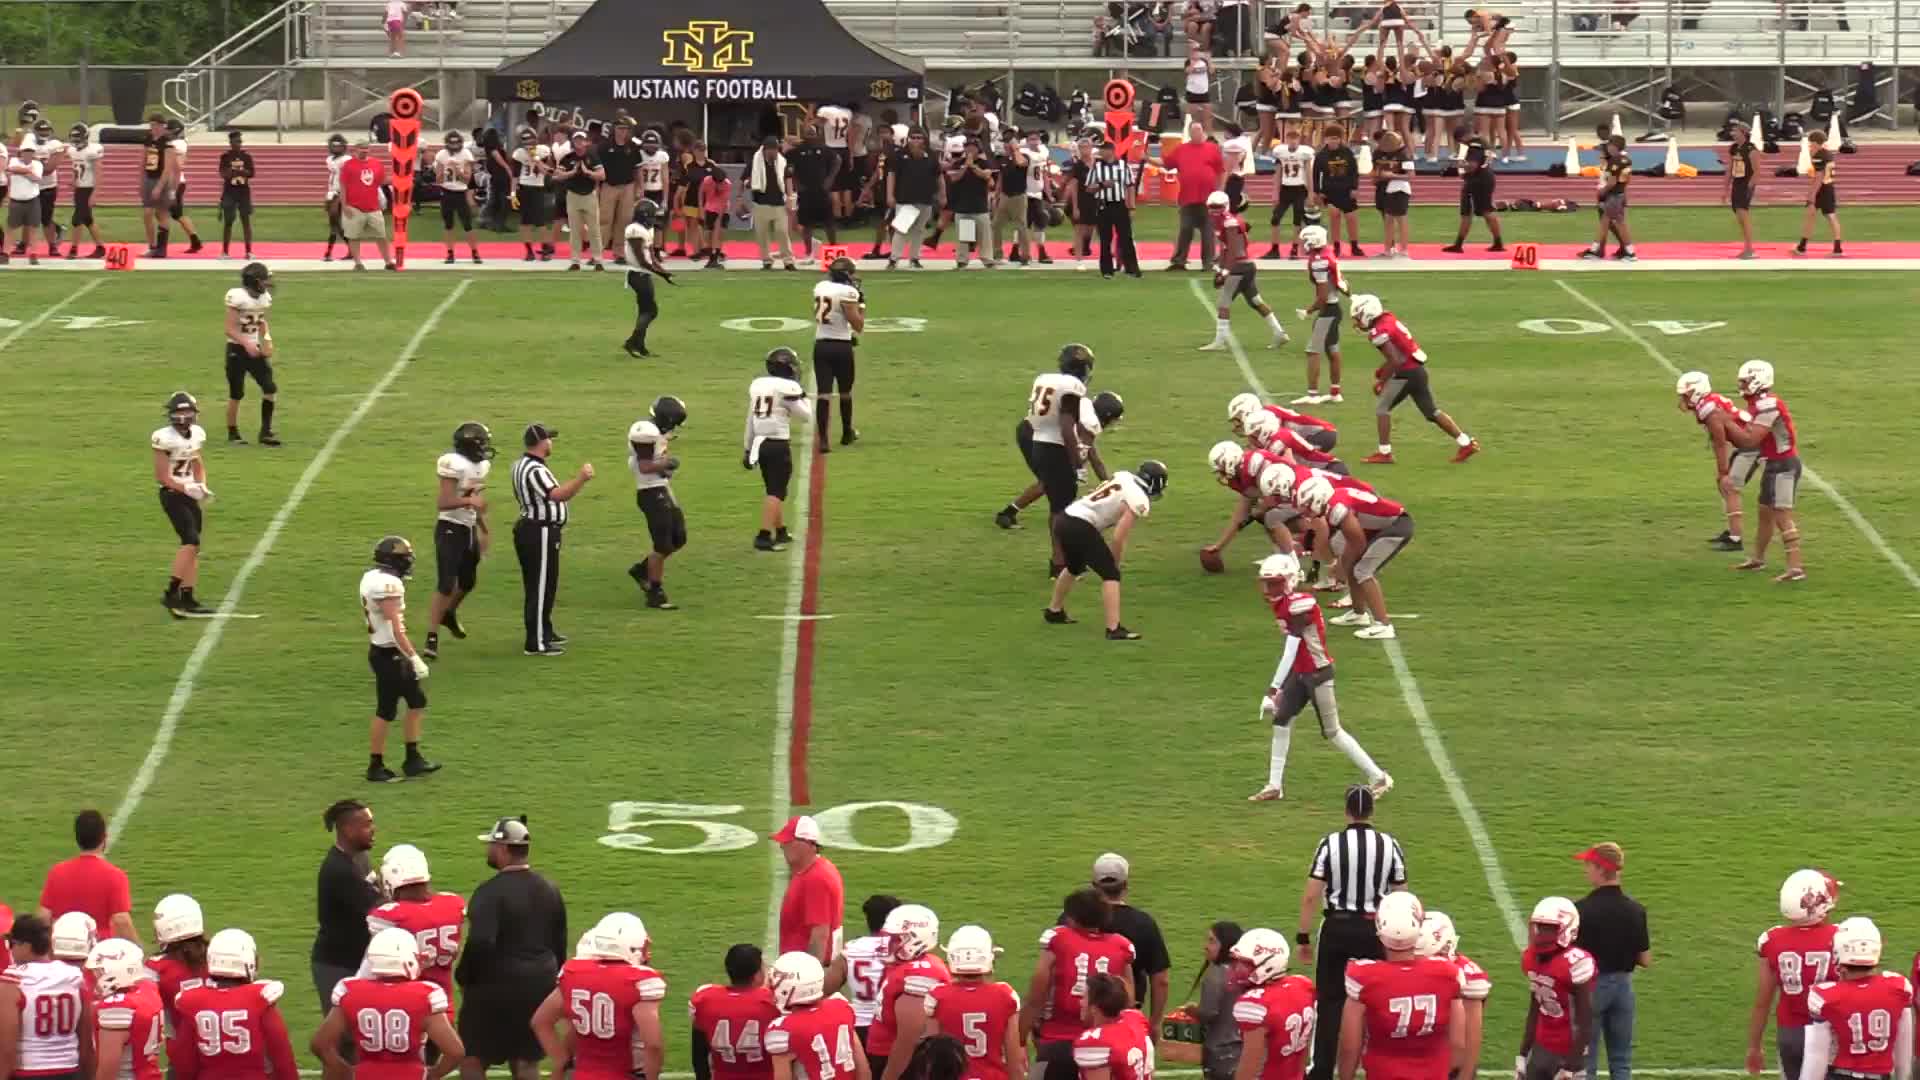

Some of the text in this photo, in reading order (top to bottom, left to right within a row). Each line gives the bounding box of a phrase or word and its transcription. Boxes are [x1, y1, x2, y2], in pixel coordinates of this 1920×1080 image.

[613, 79, 797, 99] MUSTANG FOOTBALL
[106, 247, 129, 266] 40
[1514, 246, 1536, 265] 40
[1778, 951, 1831, 995] 87
[35, 992, 74, 1037] 80
[194, 1009, 251, 1056] 95
[356, 1007, 410, 1053] 98
[571, 989, 615, 1039] 50
[962, 1012, 988, 1057] 5
[1388, 994, 1437, 1038] 77
[1847, 1008, 1891, 1054] 19
[711, 1019, 763, 1064] 44
[811, 1023, 855, 1080] 14
